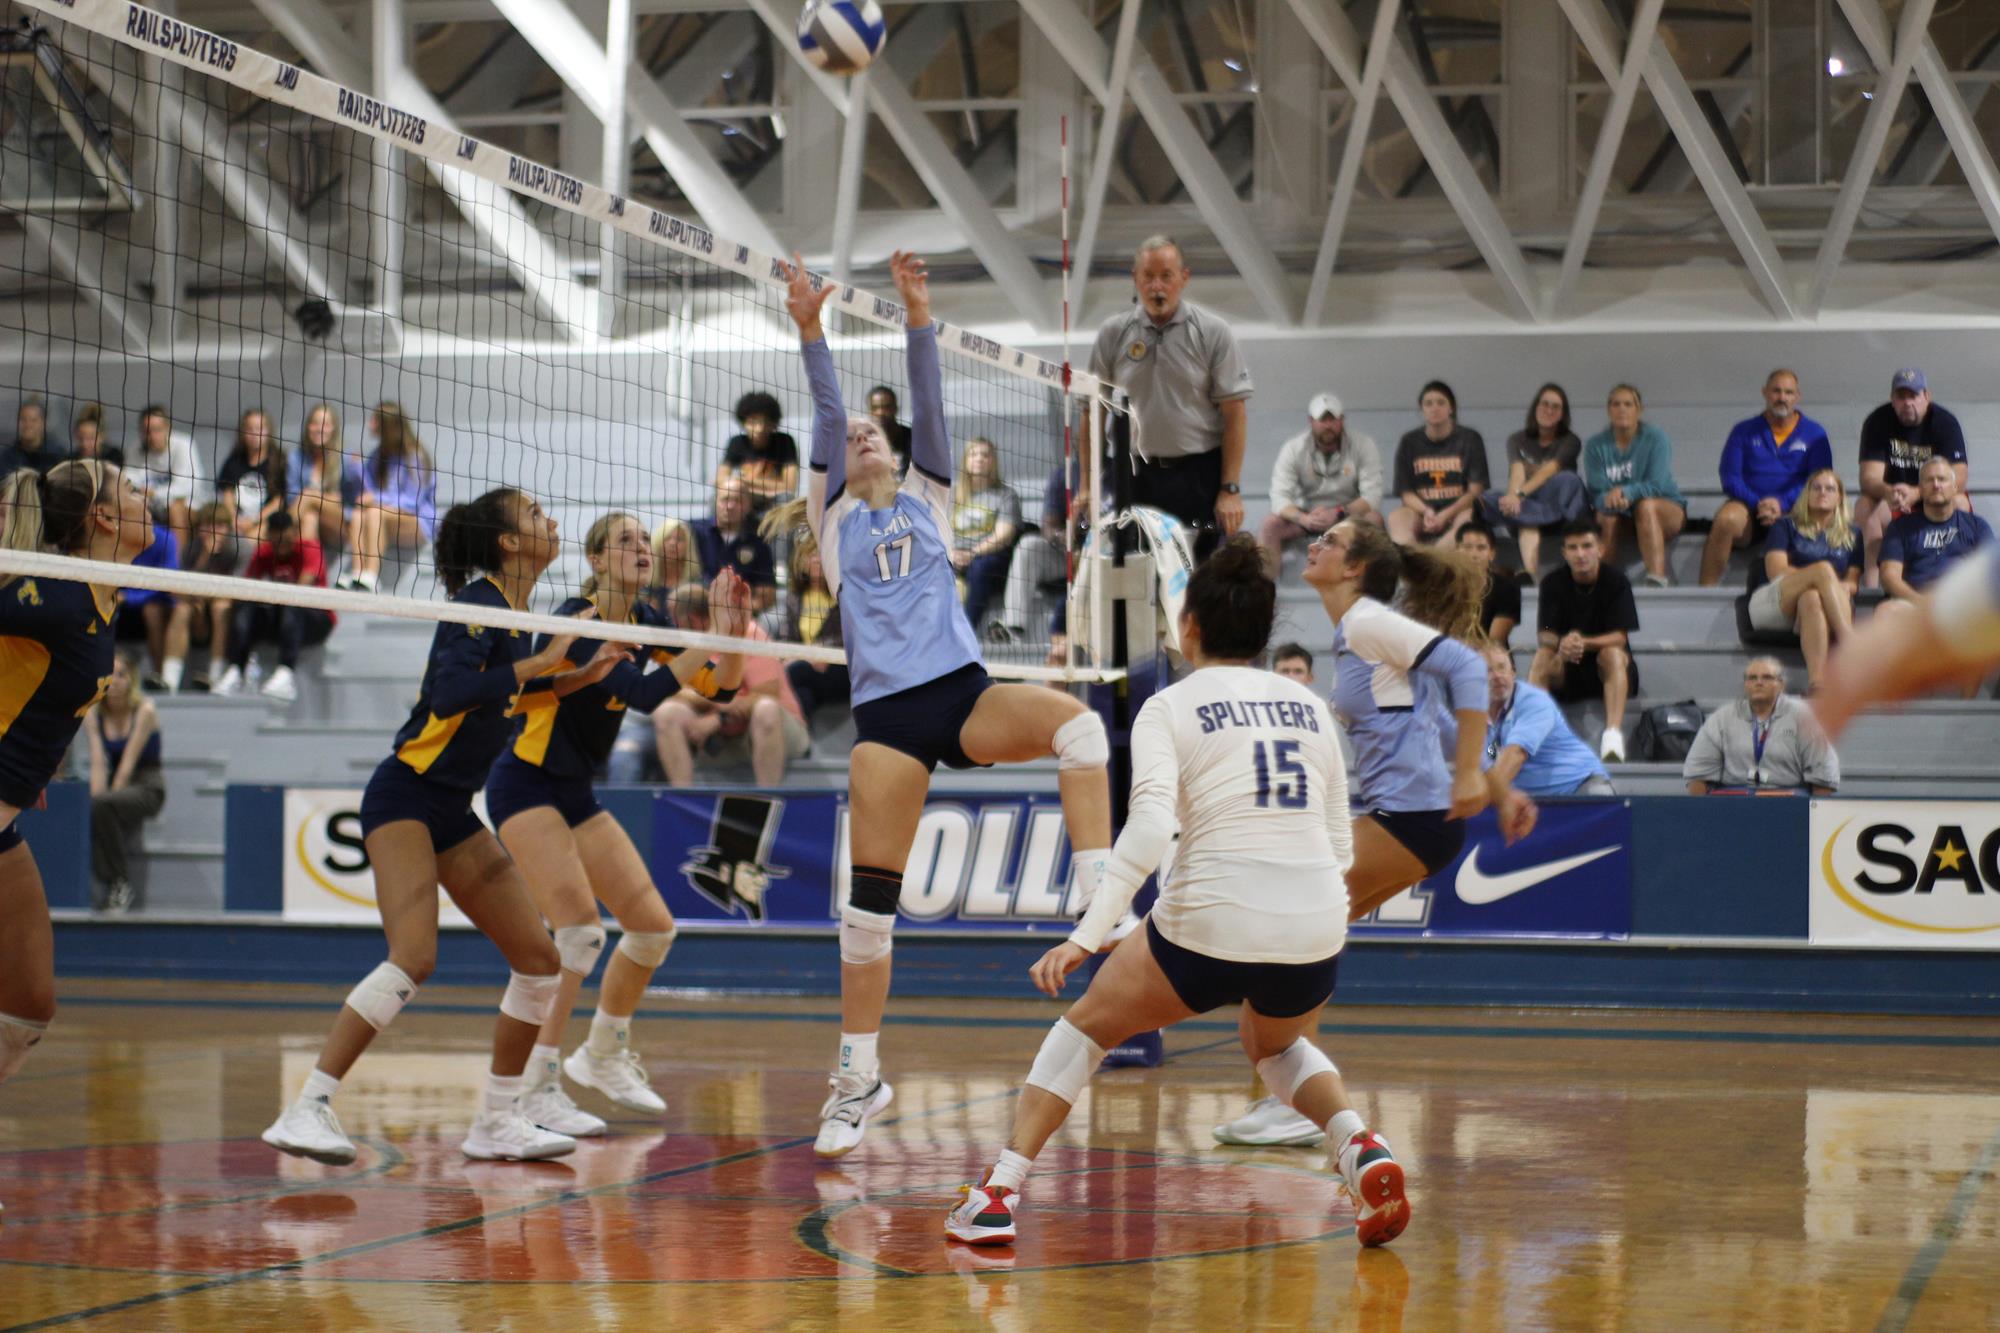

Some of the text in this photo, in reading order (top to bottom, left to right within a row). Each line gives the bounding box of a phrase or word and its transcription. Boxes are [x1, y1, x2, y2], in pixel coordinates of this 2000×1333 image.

[126, 6, 239, 72] RAILSPLITTERS
[274, 63, 299, 91] LMU
[337, 88, 427, 145] RAILSPLITTERS
[457, 136, 479, 161] LMU
[508, 156, 584, 206] RAILSPLITTERS
[649, 210, 714, 254] RAILSPLITTERS
[873, 531, 912, 582] 17
[1195, 701, 1320, 734] SPLITTERS
[1253, 739, 1309, 810] 15
